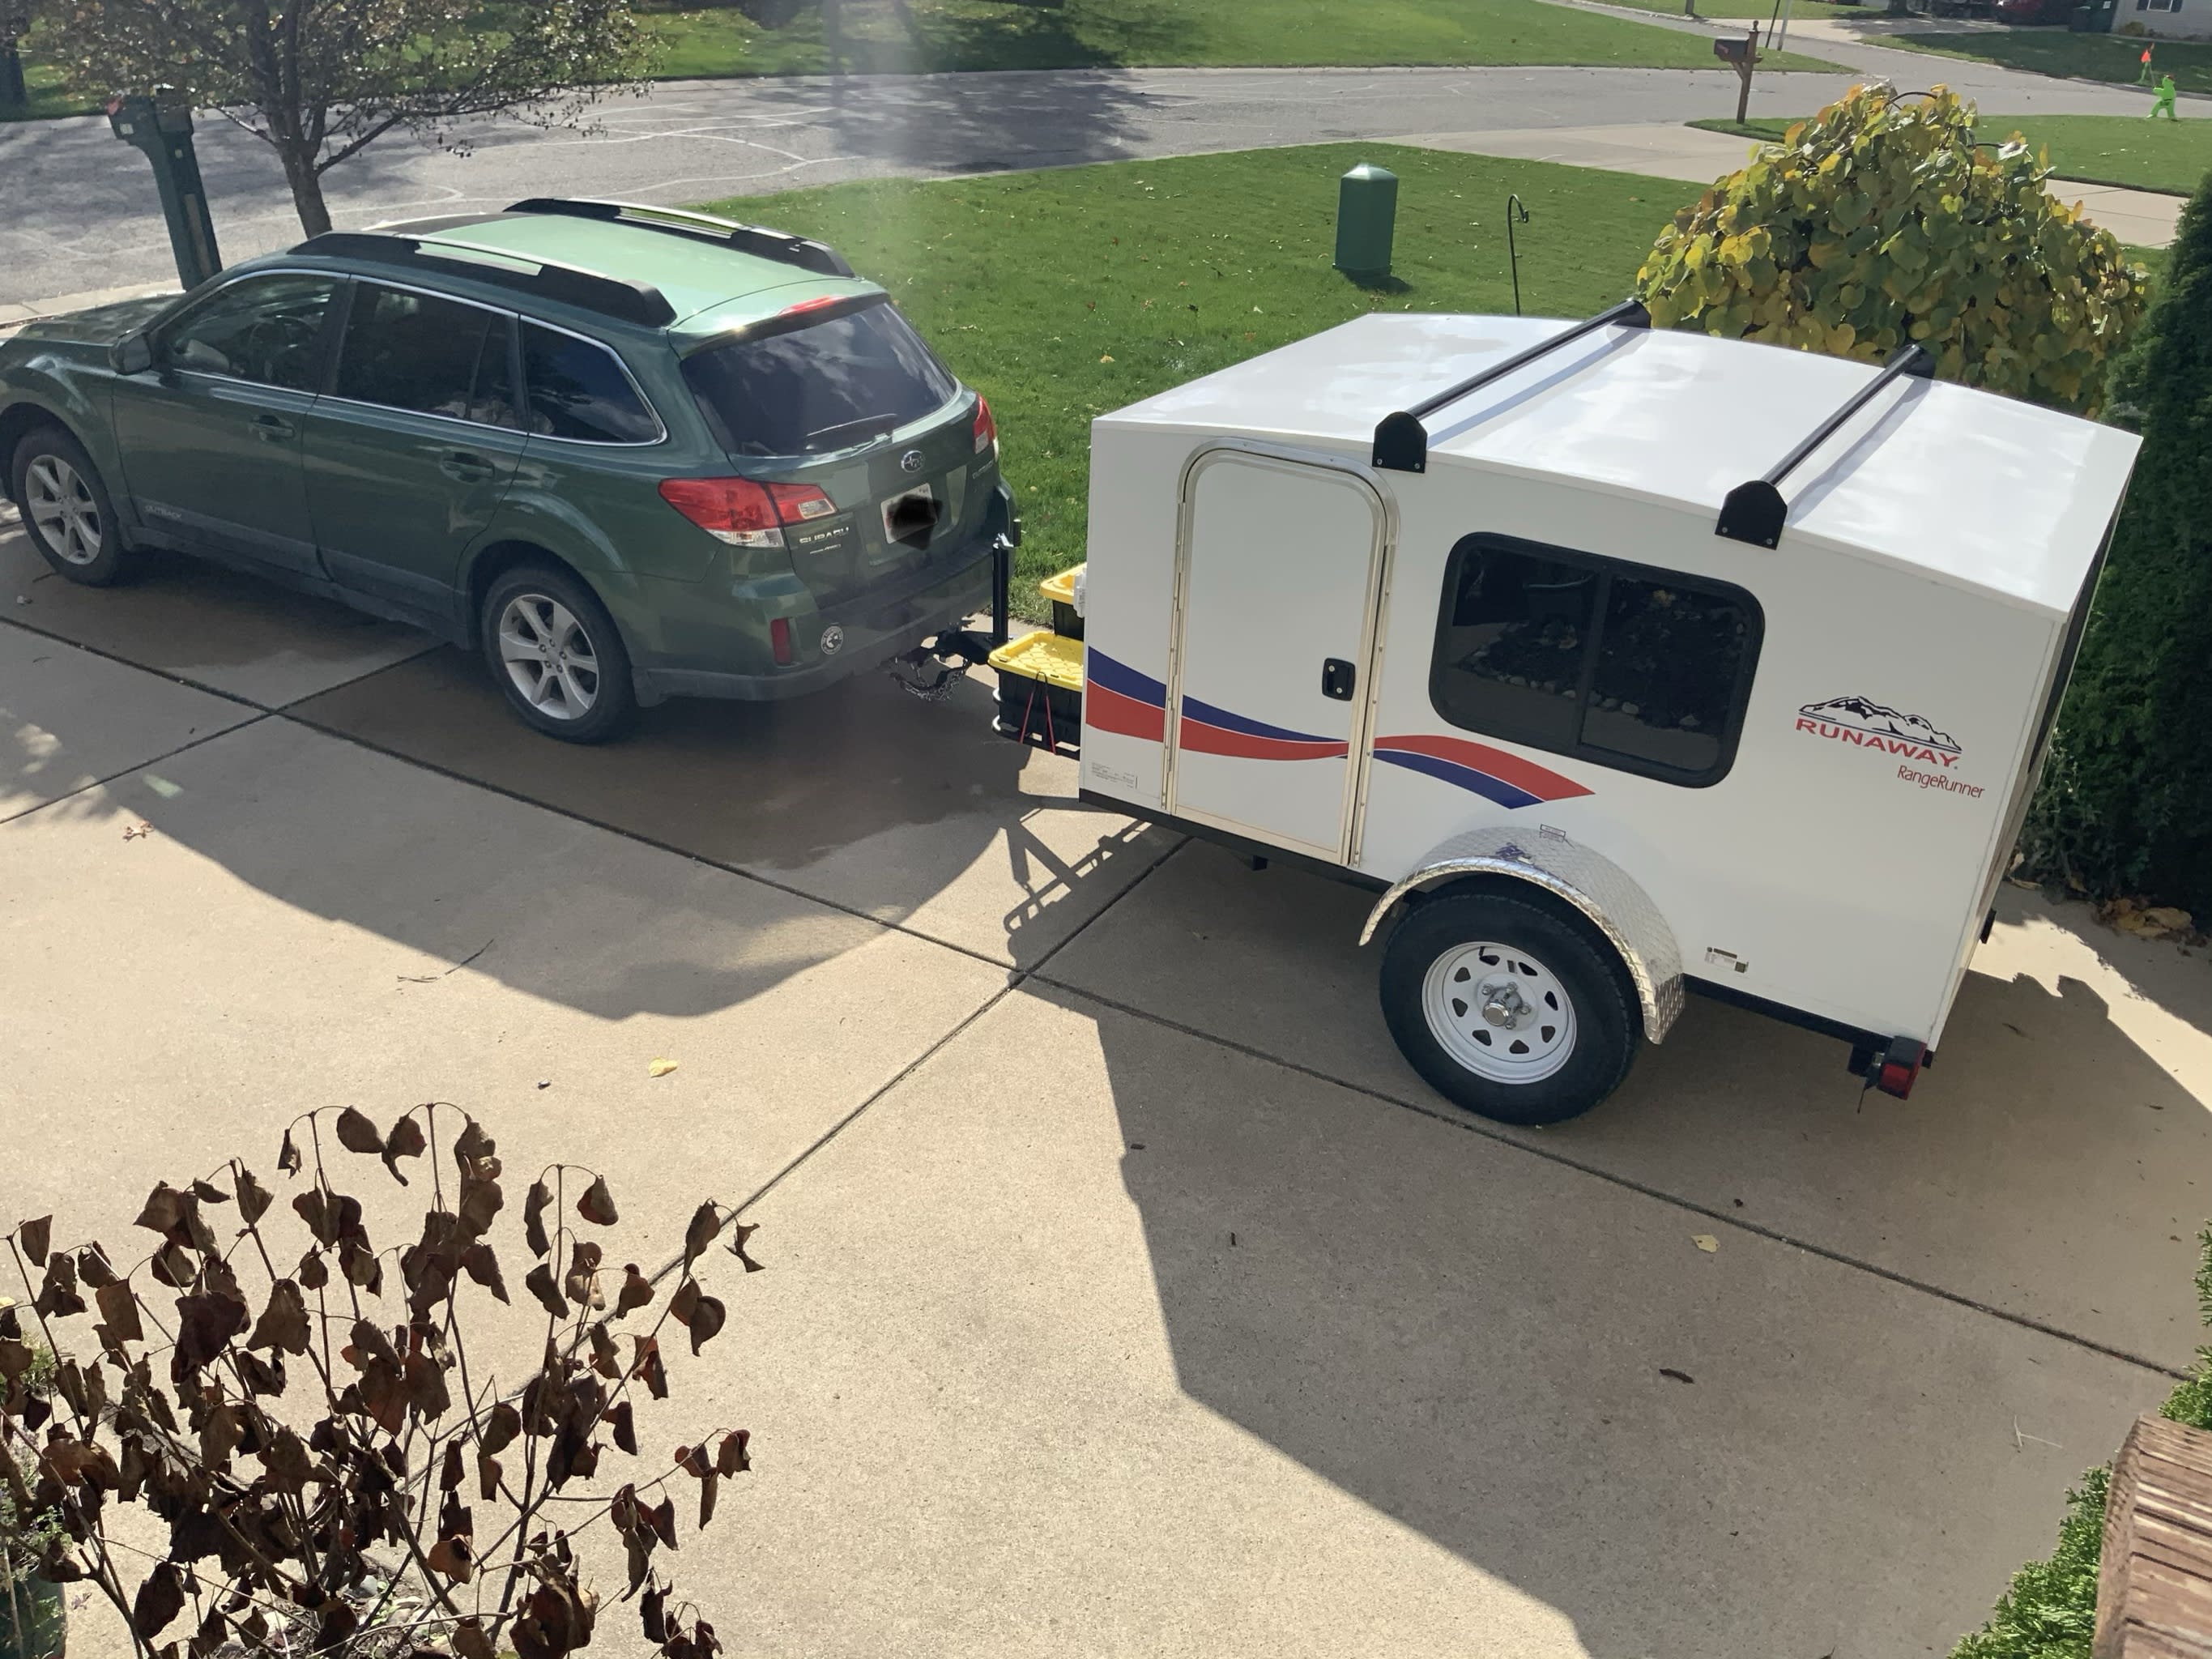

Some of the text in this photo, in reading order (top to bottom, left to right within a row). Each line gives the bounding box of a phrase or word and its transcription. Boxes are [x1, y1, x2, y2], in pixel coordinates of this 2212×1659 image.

[799, 527, 850, 544] SUBARU
[1796, 718, 1960, 768] RUNAWAY
[1897, 765, 1985, 798] RangeRunner
